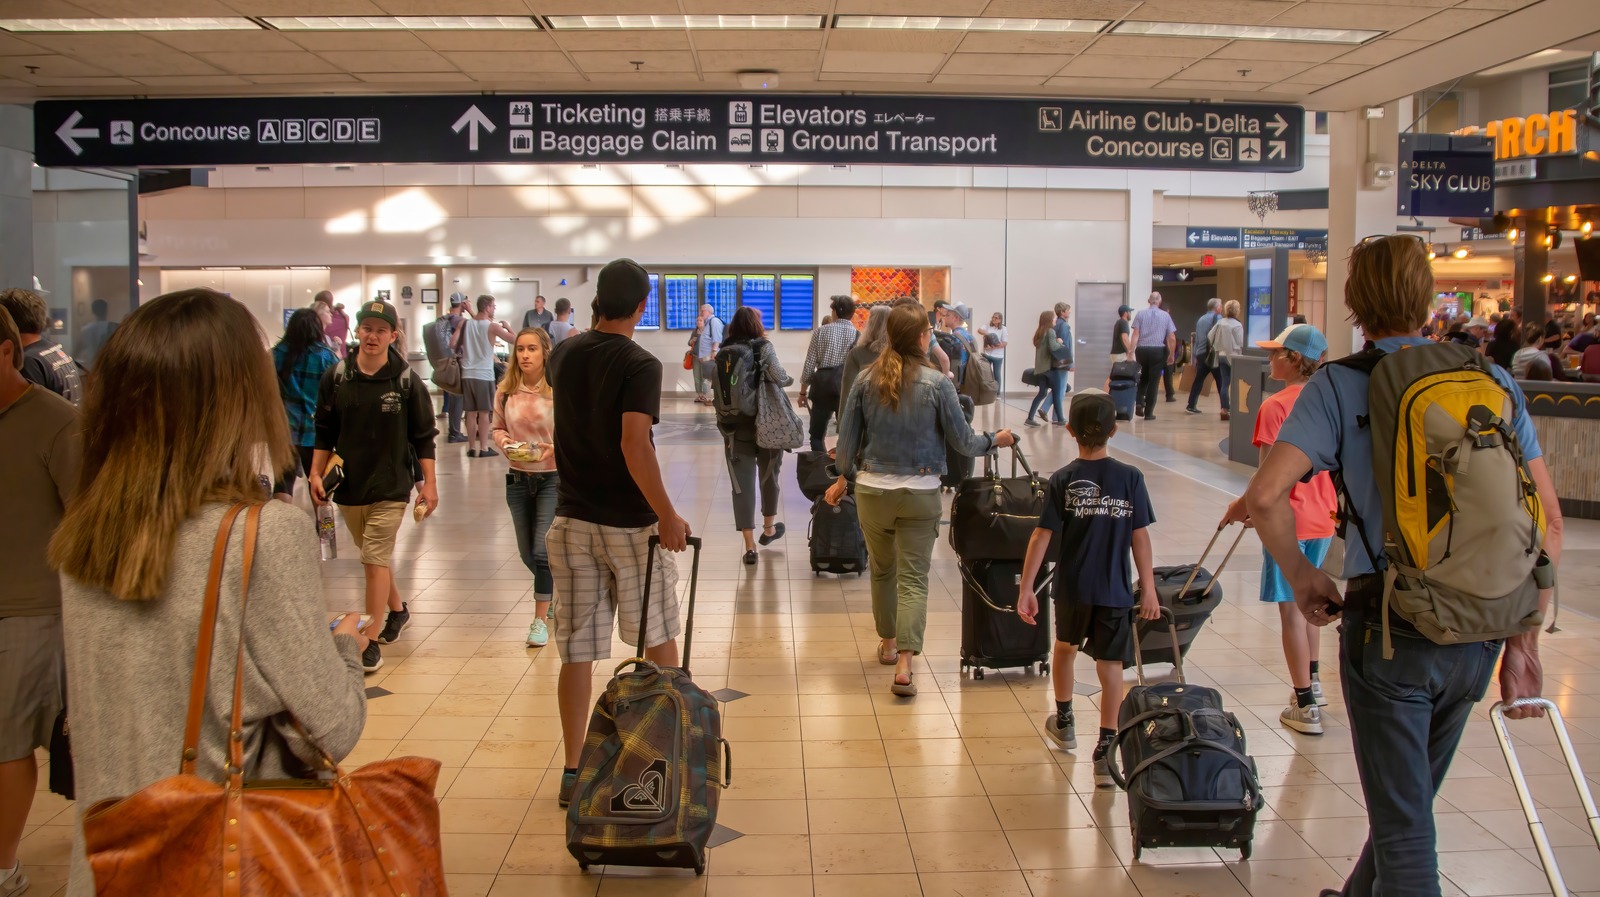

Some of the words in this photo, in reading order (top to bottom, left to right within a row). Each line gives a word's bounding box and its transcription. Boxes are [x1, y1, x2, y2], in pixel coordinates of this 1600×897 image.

[541, 103, 646, 128] Ticketing
[654, 107, 711, 122] 搭乗手続
[760, 104, 867, 125] Elevators
[874, 112, 935, 123] エレベーター
[1069, 110, 1136, 130] Airline
[1144, 111, 1260, 133] Club-Delta
[140, 122, 250, 142] Concourse
[541, 131, 644, 155] Baggage
[652, 130, 716, 151] Claim
[792, 130, 879, 151] Ground
[886, 131, 997, 156] Transport
[1087, 135, 1204, 158] Concourse
[1213, 139, 1230, 159] G
[1411, 160, 1446, 169] DELTA
[1410, 173, 1443, 190] SKY
[1447, 174, 1491, 191] CLUB
[1211, 234, 1238, 242] Elevators
